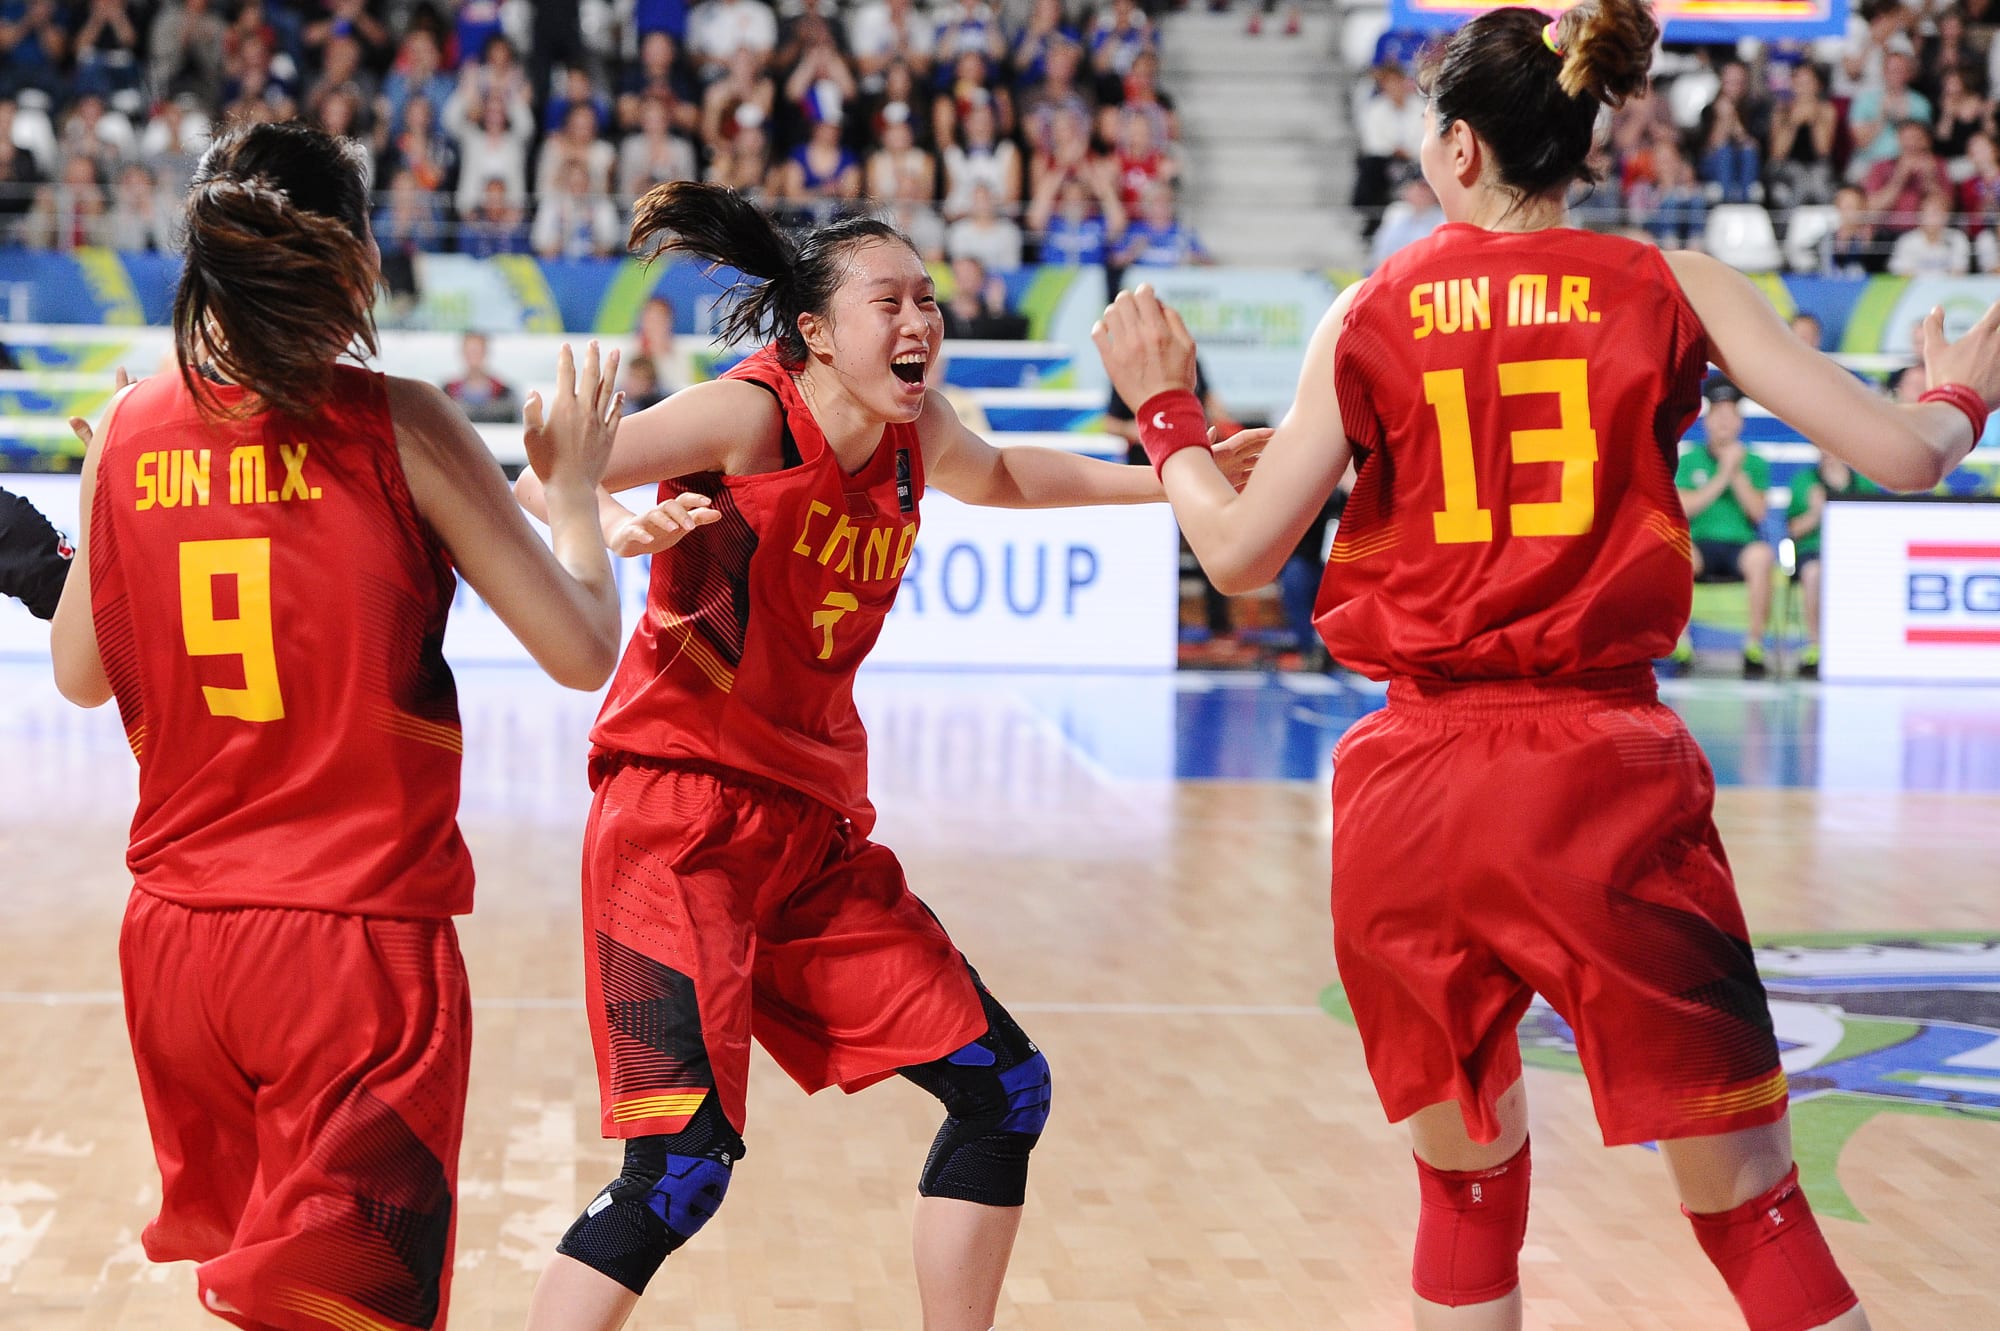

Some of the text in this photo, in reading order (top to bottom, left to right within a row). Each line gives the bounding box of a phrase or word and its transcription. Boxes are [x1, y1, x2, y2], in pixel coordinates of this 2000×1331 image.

[1409, 274, 1601, 340] SUN M.R.
[135, 443, 322, 511] SUN M.X.
[1423, 358, 1599, 544] 13
[889, 541, 1101, 616] ROUP
[178, 537, 285, 723] 9
[812, 591, 859, 660] 7
